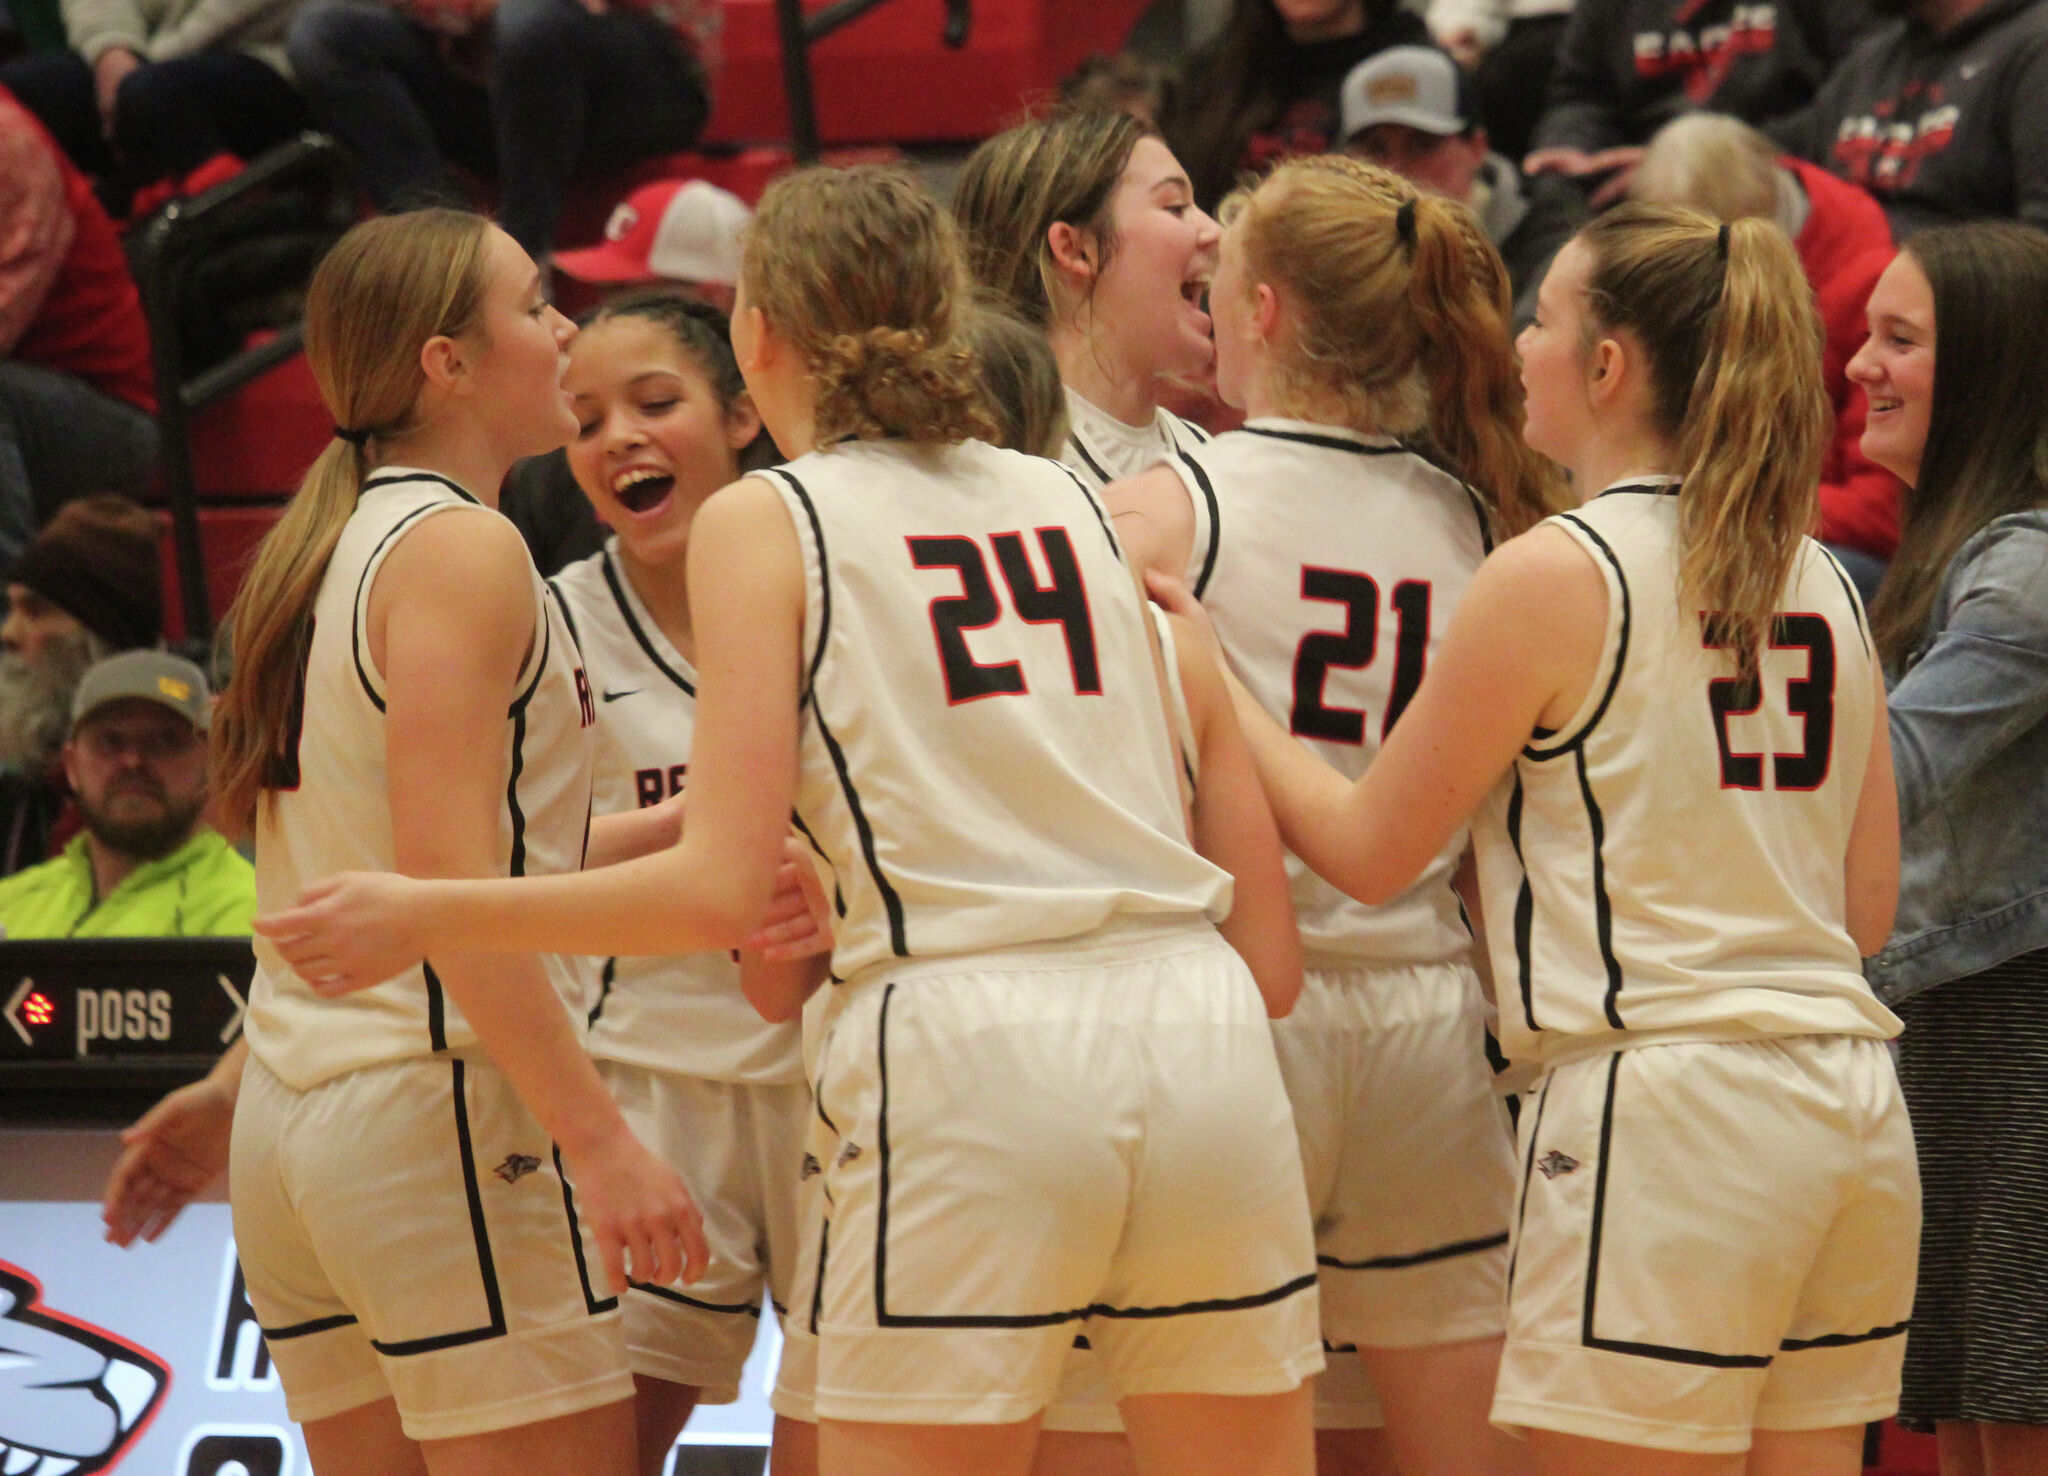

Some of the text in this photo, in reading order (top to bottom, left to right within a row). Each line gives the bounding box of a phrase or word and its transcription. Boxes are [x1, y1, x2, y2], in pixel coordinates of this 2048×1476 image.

[903, 525, 1104, 707] 24
[1289, 563, 1432, 746] 21
[1698, 610, 1837, 792] 23
